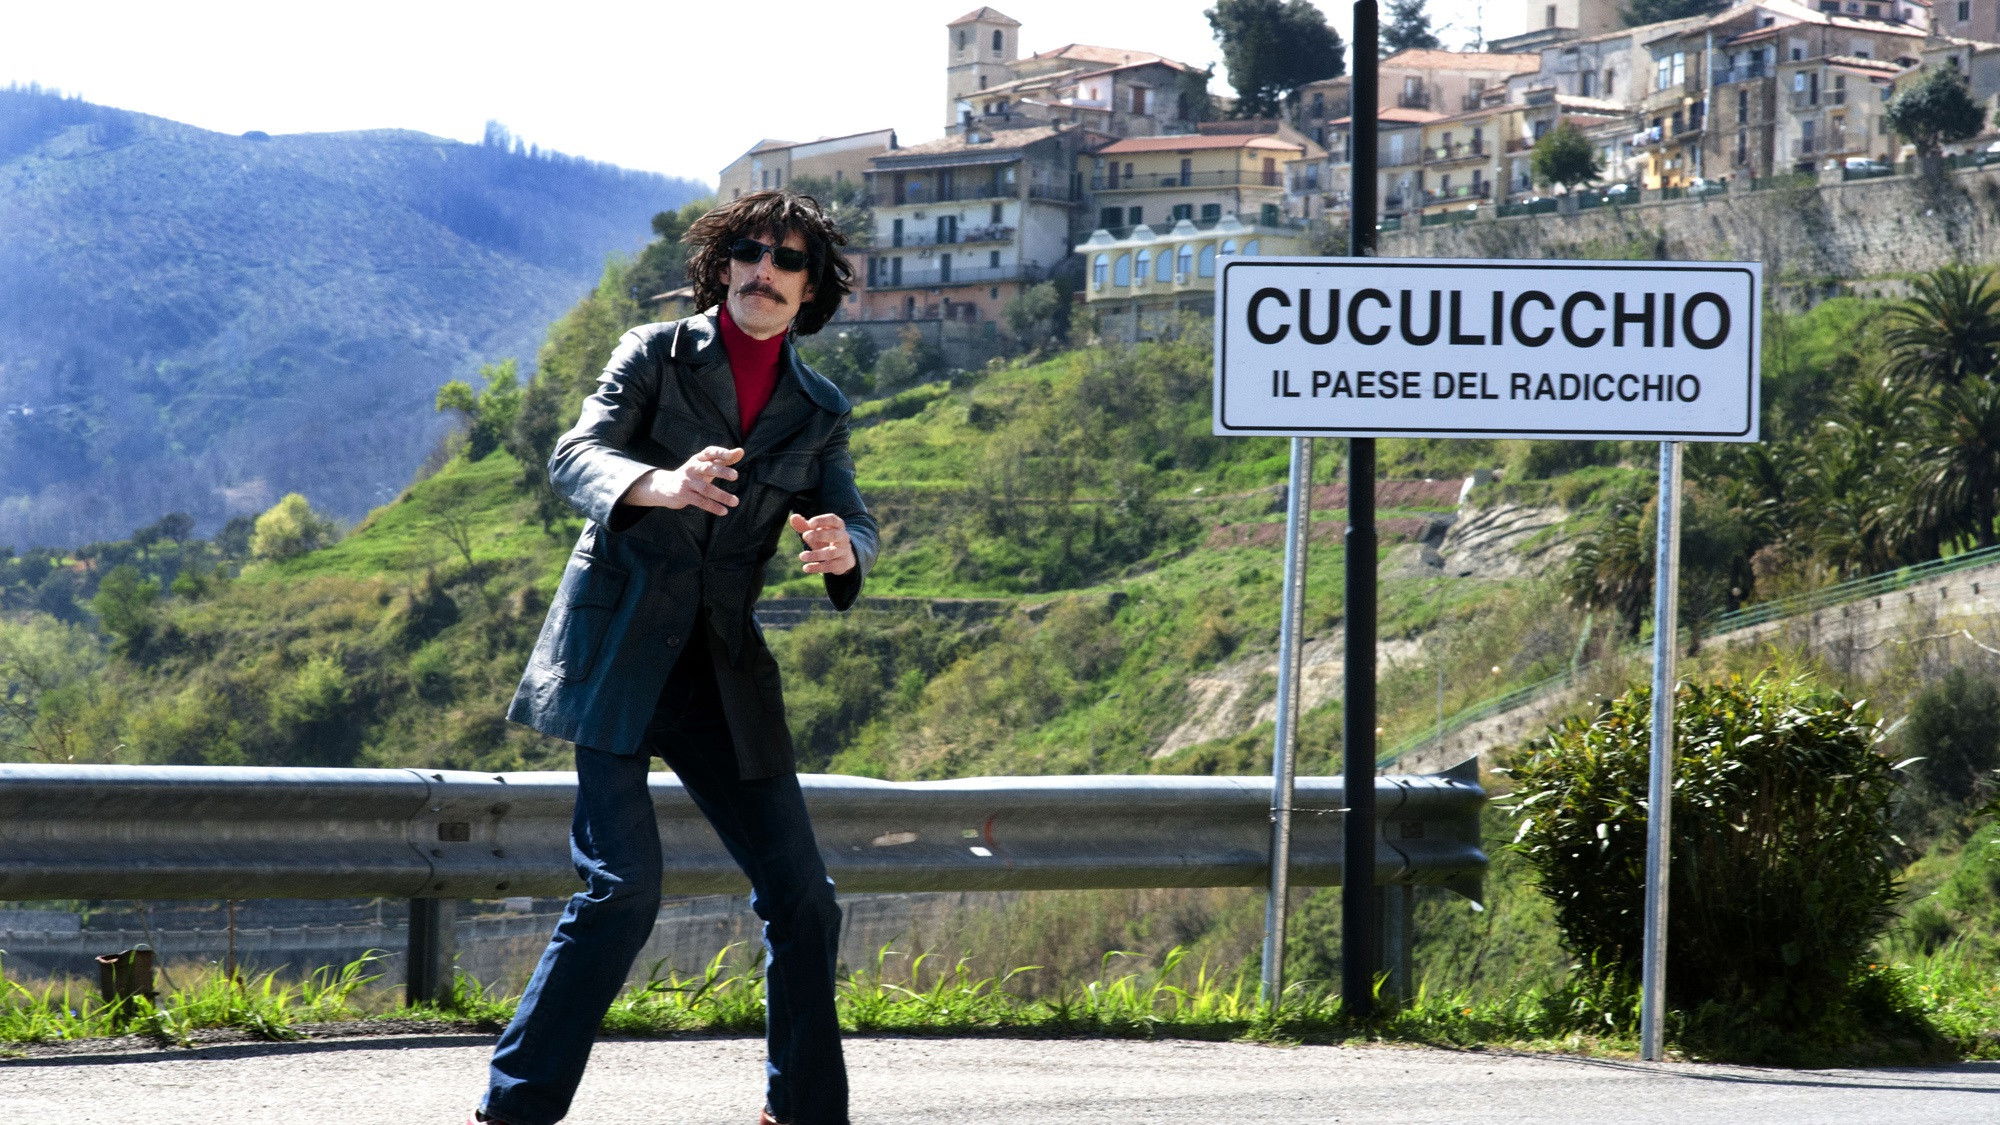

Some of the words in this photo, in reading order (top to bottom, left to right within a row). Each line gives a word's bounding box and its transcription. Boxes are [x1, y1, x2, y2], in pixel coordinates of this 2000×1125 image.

[1246, 287, 1731, 349] CUCULICCHIO
[1272, 370, 1301, 398] IL
[1311, 370, 1421, 399] PAESE
[1433, 371, 1499, 400] DEL
[1510, 372, 1701, 403] RADICCHIO
